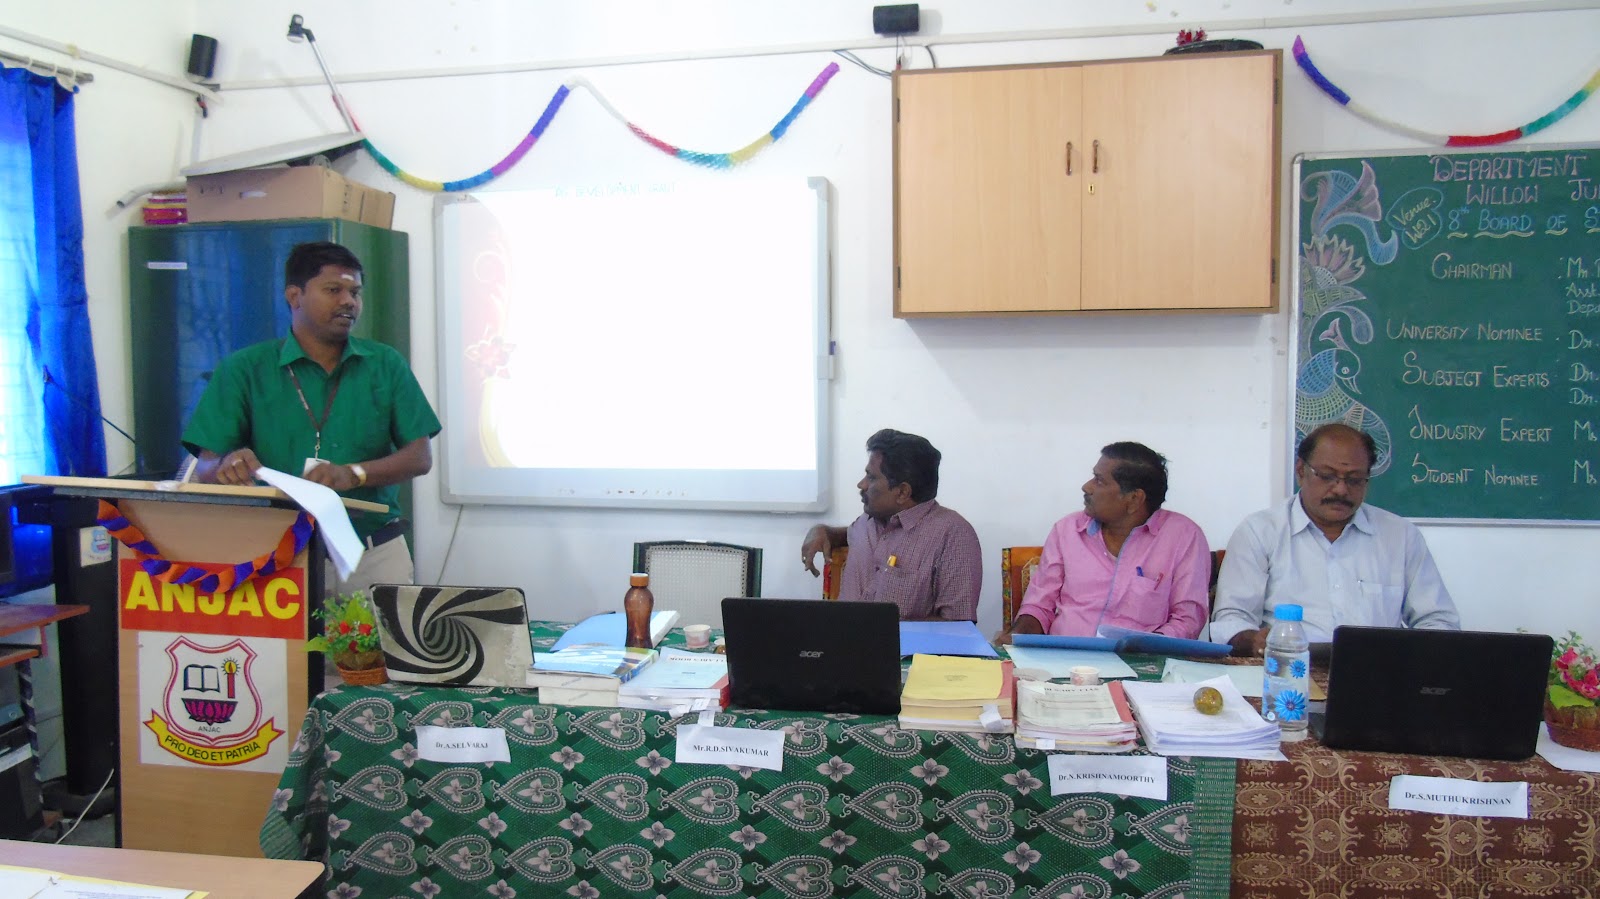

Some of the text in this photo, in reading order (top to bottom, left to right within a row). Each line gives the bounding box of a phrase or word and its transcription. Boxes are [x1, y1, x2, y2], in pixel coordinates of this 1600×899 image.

[1430, 154, 1587, 182] DEPARTMENT
[1466, 178, 1600, 205] WILLOW JU
[1478, 208, 1532, 232] BOARD
[1546, 214, 1567, 231] OF
[1431, 252, 1513, 280] CHAIRMAN
[1386, 318, 1469, 341] UNIVERSITY
[1477, 322, 1543, 341] NOMINEE
[1493, 365, 1550, 388] EXPERTS
[1408, 404, 1486, 440] INDUSTRY
[1500, 417, 1552, 442] EXPERT
[1412, 452, 1474, 484] STUDENT
[1484, 464, 1539, 486] NOMINEE
[125, 571, 300, 620] ANJAC
[799, 650, 825, 658] acer
[1420, 687, 1452, 696] acer
[198, 725, 221, 733] ANJAC
[164, 735, 261, 761] PRO DEO ET PATRIA
[693, 744, 769, 757] Mr.R.D.SIVAKUMAR
[1058, 773, 1156, 784] Dr.N.KRISHNAMOORTHY
[1405, 791, 1512, 805] Dr.S.MUTHUKRISHNAN
